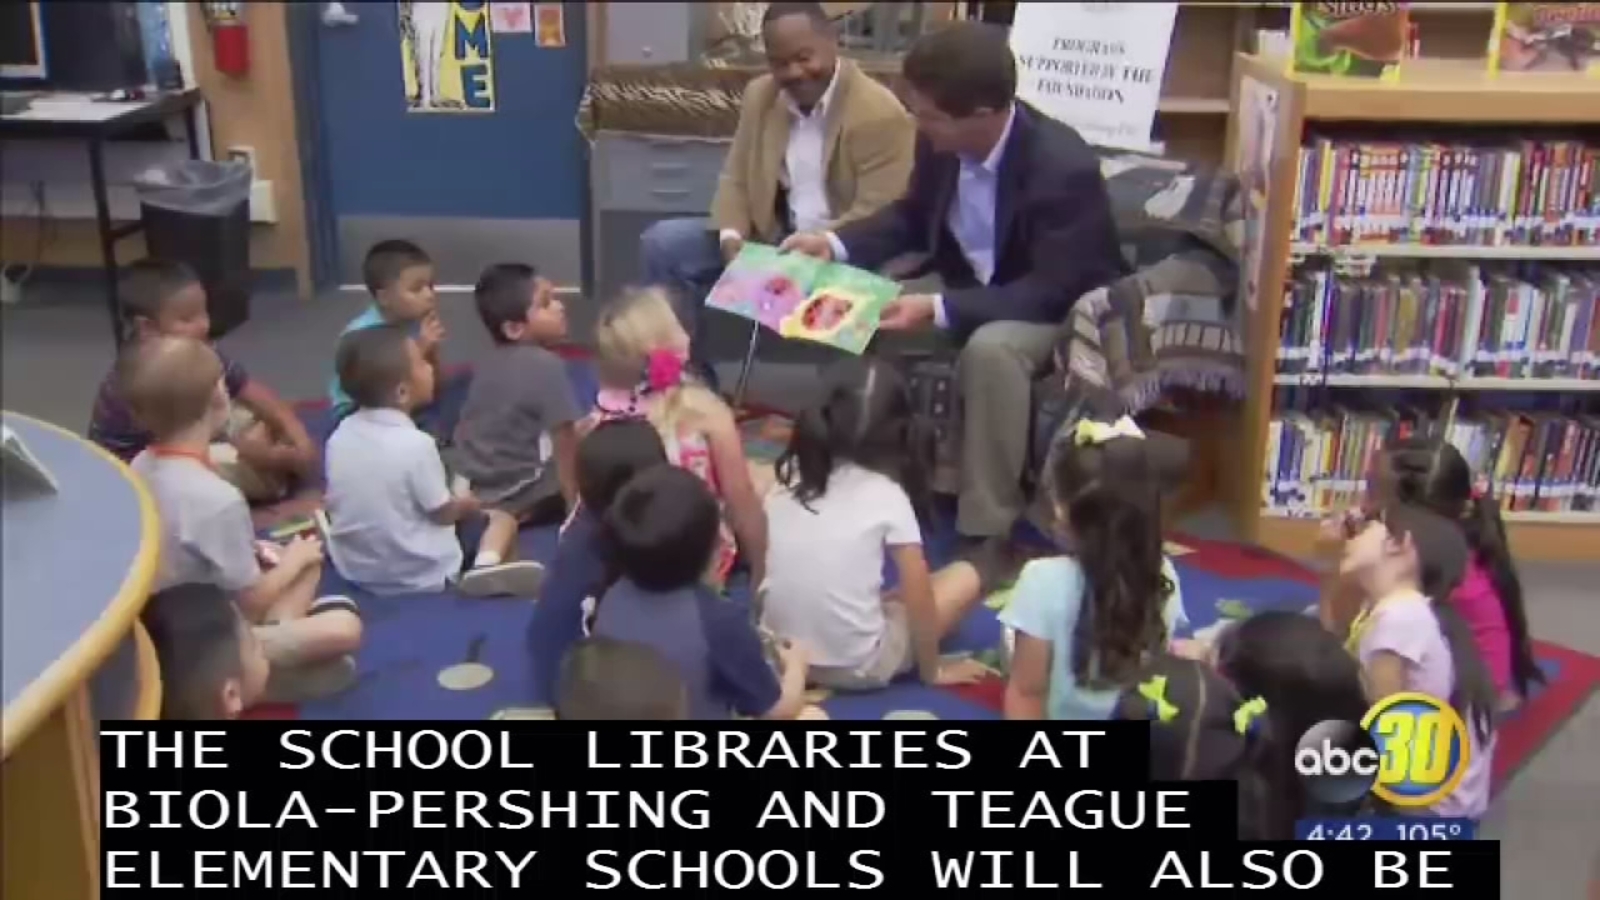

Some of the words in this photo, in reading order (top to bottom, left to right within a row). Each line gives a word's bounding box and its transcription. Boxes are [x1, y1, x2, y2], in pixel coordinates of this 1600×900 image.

[454, 2, 490, 107] ME
[1123, 67, 1154, 84] THE
[1037, 80, 1125, 104] FOUNDATION
